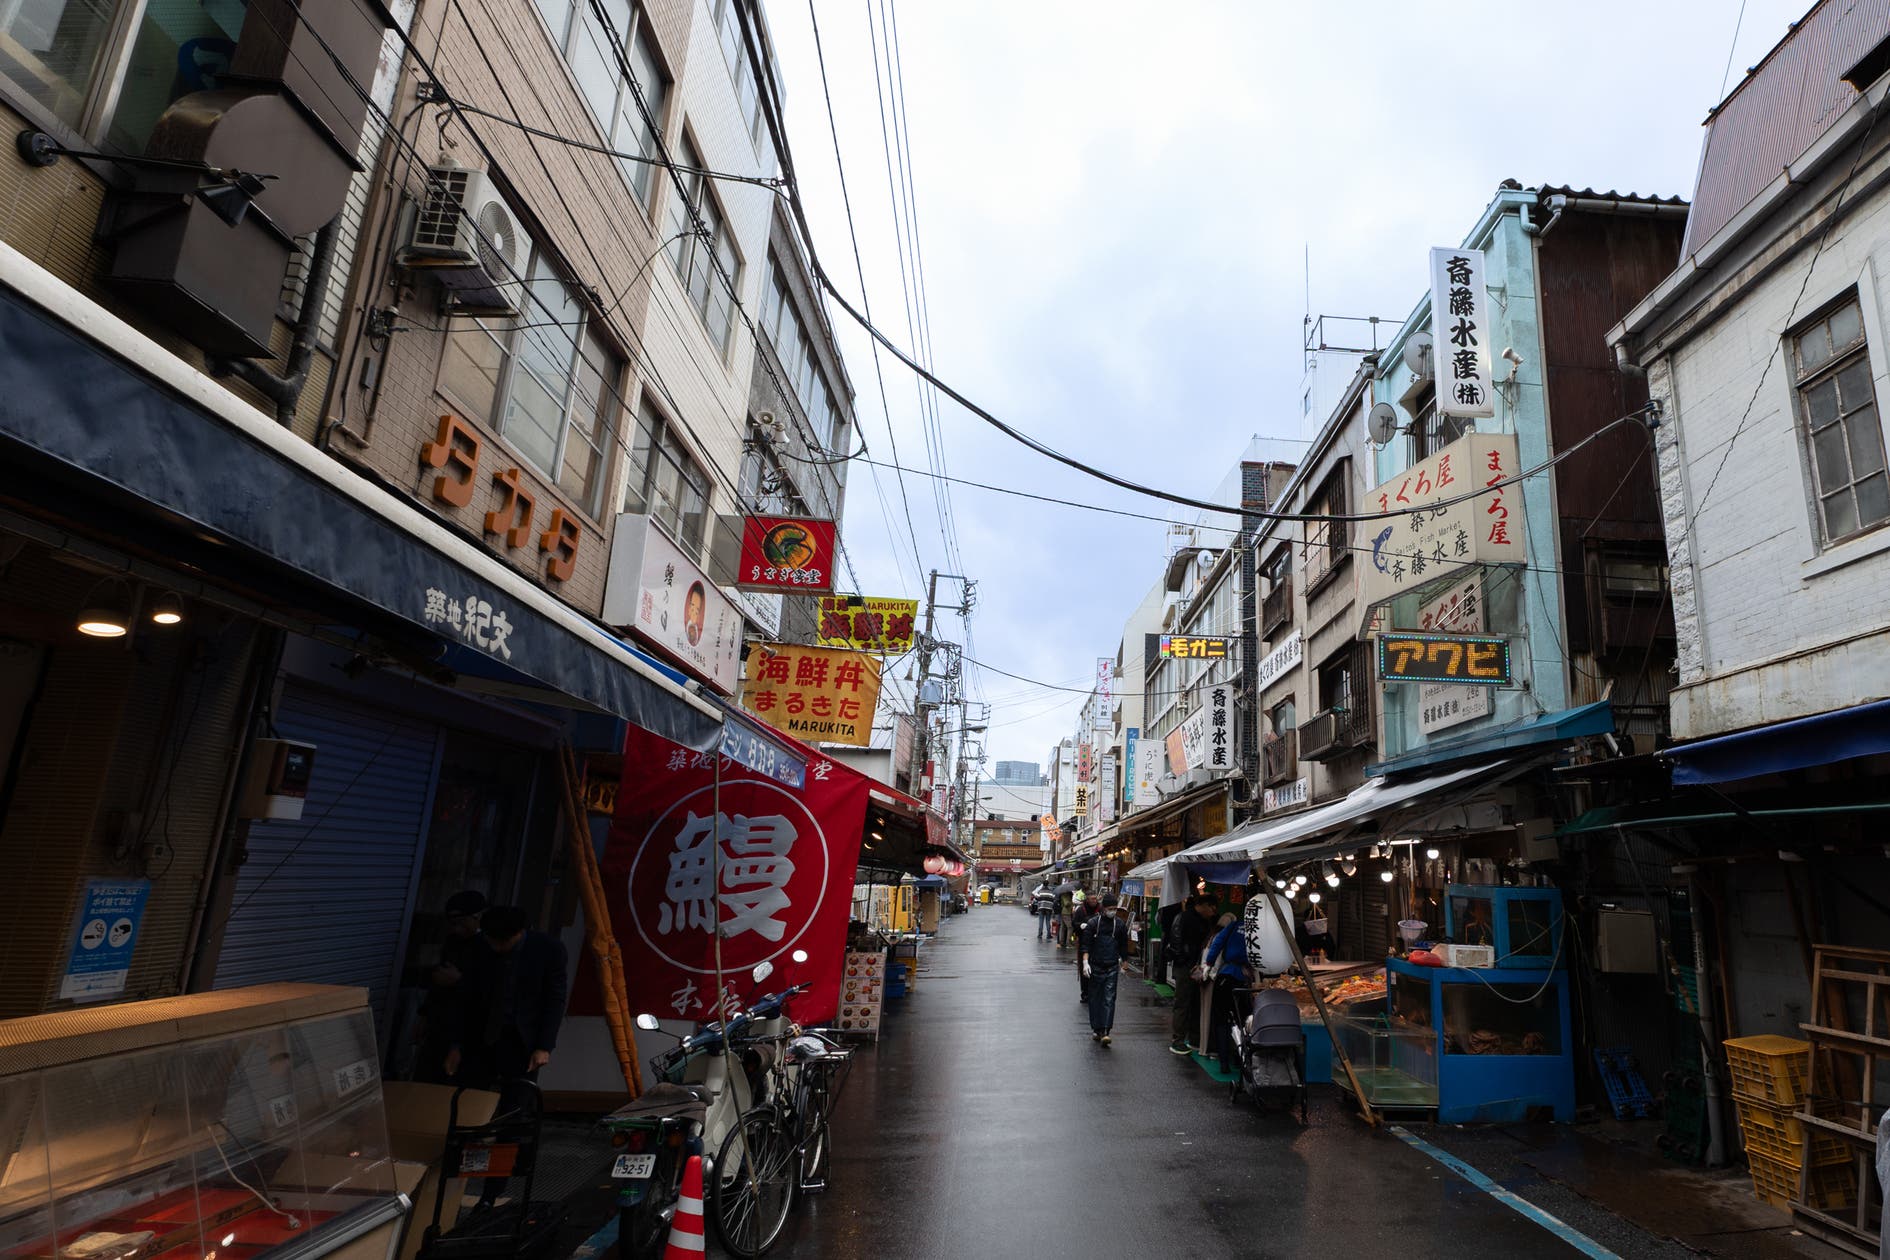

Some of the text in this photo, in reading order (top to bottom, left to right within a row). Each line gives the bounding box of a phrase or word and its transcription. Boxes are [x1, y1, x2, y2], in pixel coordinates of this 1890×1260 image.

[421, 414, 581, 583] タカタ
[1378, 453, 1455, 515] まぐろ屋
[1486, 449, 1512, 546] まぐろ屋
[751, 565, 822, 585] うなぎ食堂
[423, 586, 513, 661] 築地紀文
[820, 611, 914, 642] 海鮮丼
[1170, 638, 1225, 658] 毛ガニ
[1387, 639, 1499, 677] アワビ
[756, 651, 865, 693] 海鮮丼
[754, 690, 861, 721] まるきた
[788, 718, 856, 737] MARUKITA
[656, 809, 800, 943] 鰻
[670, 977, 744, 1016] 本店
[621, 1163, 649, 1175] 92-51
